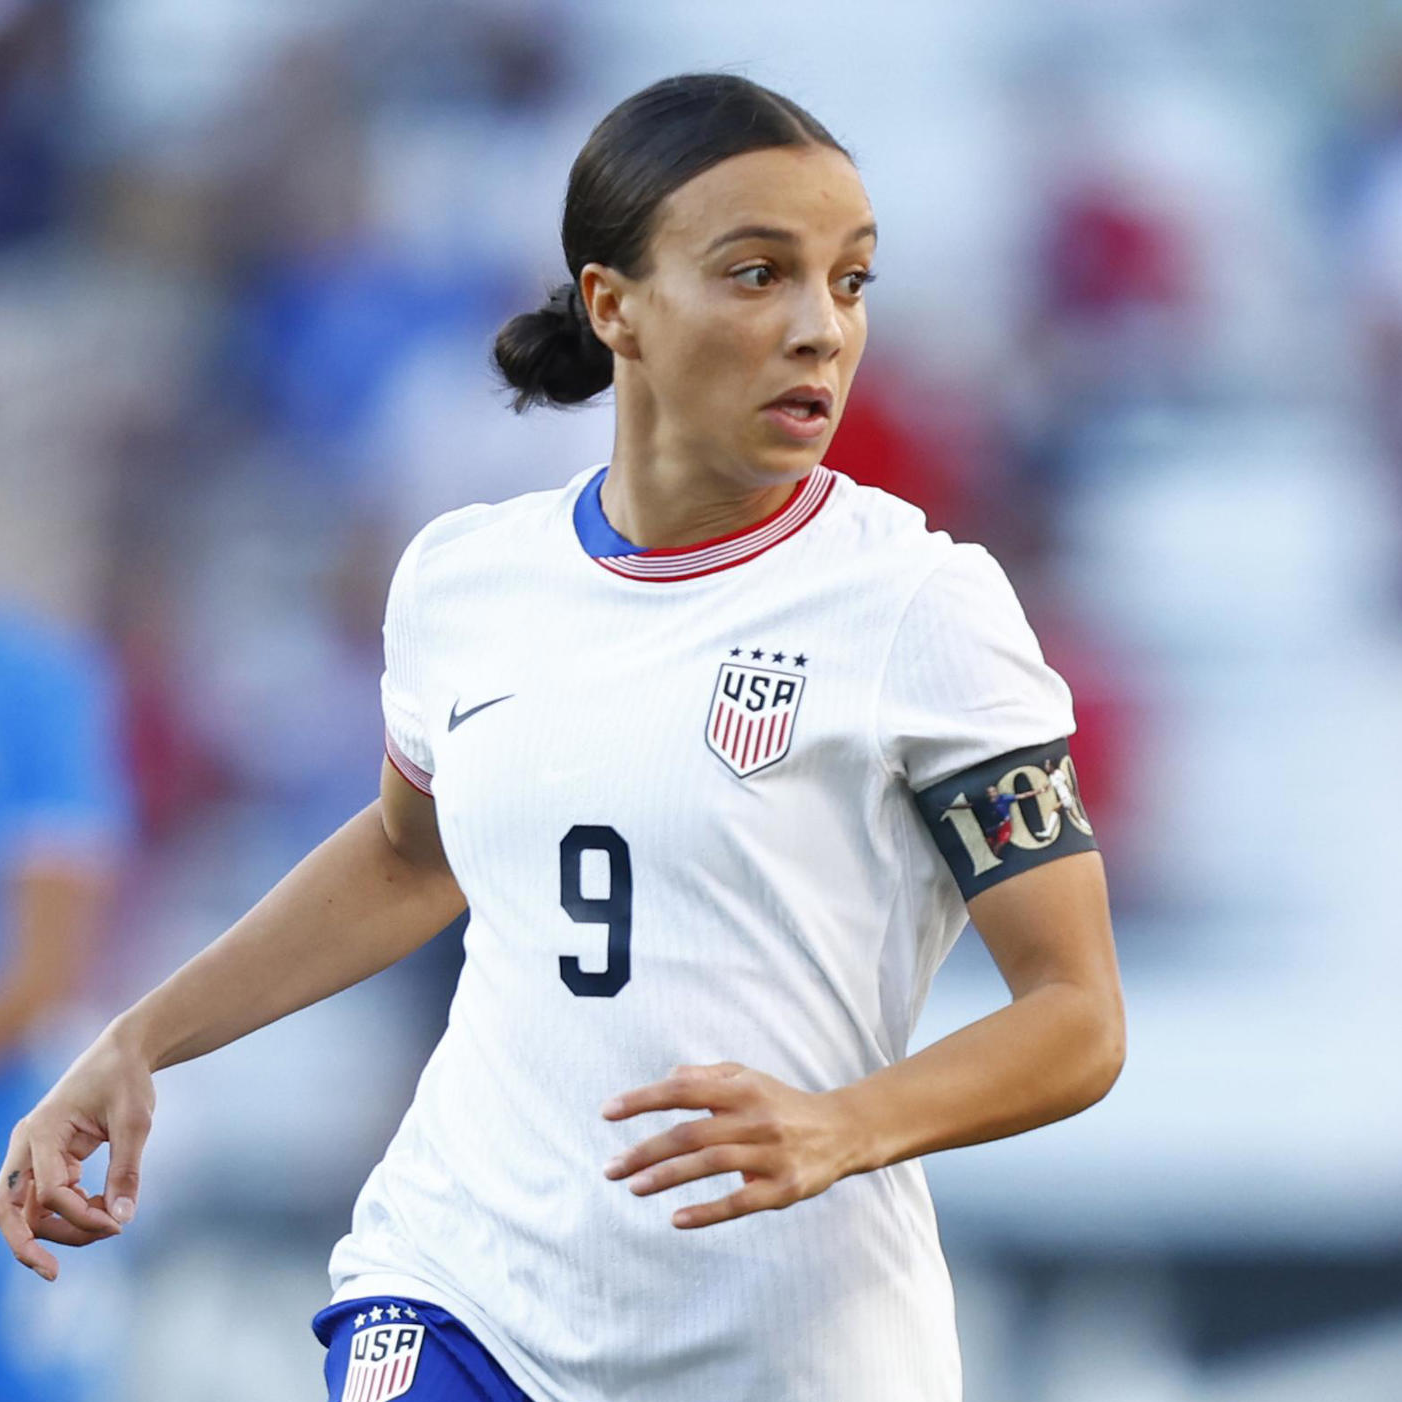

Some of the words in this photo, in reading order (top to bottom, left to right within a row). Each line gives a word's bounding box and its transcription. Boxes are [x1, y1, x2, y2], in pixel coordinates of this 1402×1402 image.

[723, 672, 796, 712] USA
[559, 825, 633, 998] 9
[354, 1329, 418, 1362] USA
